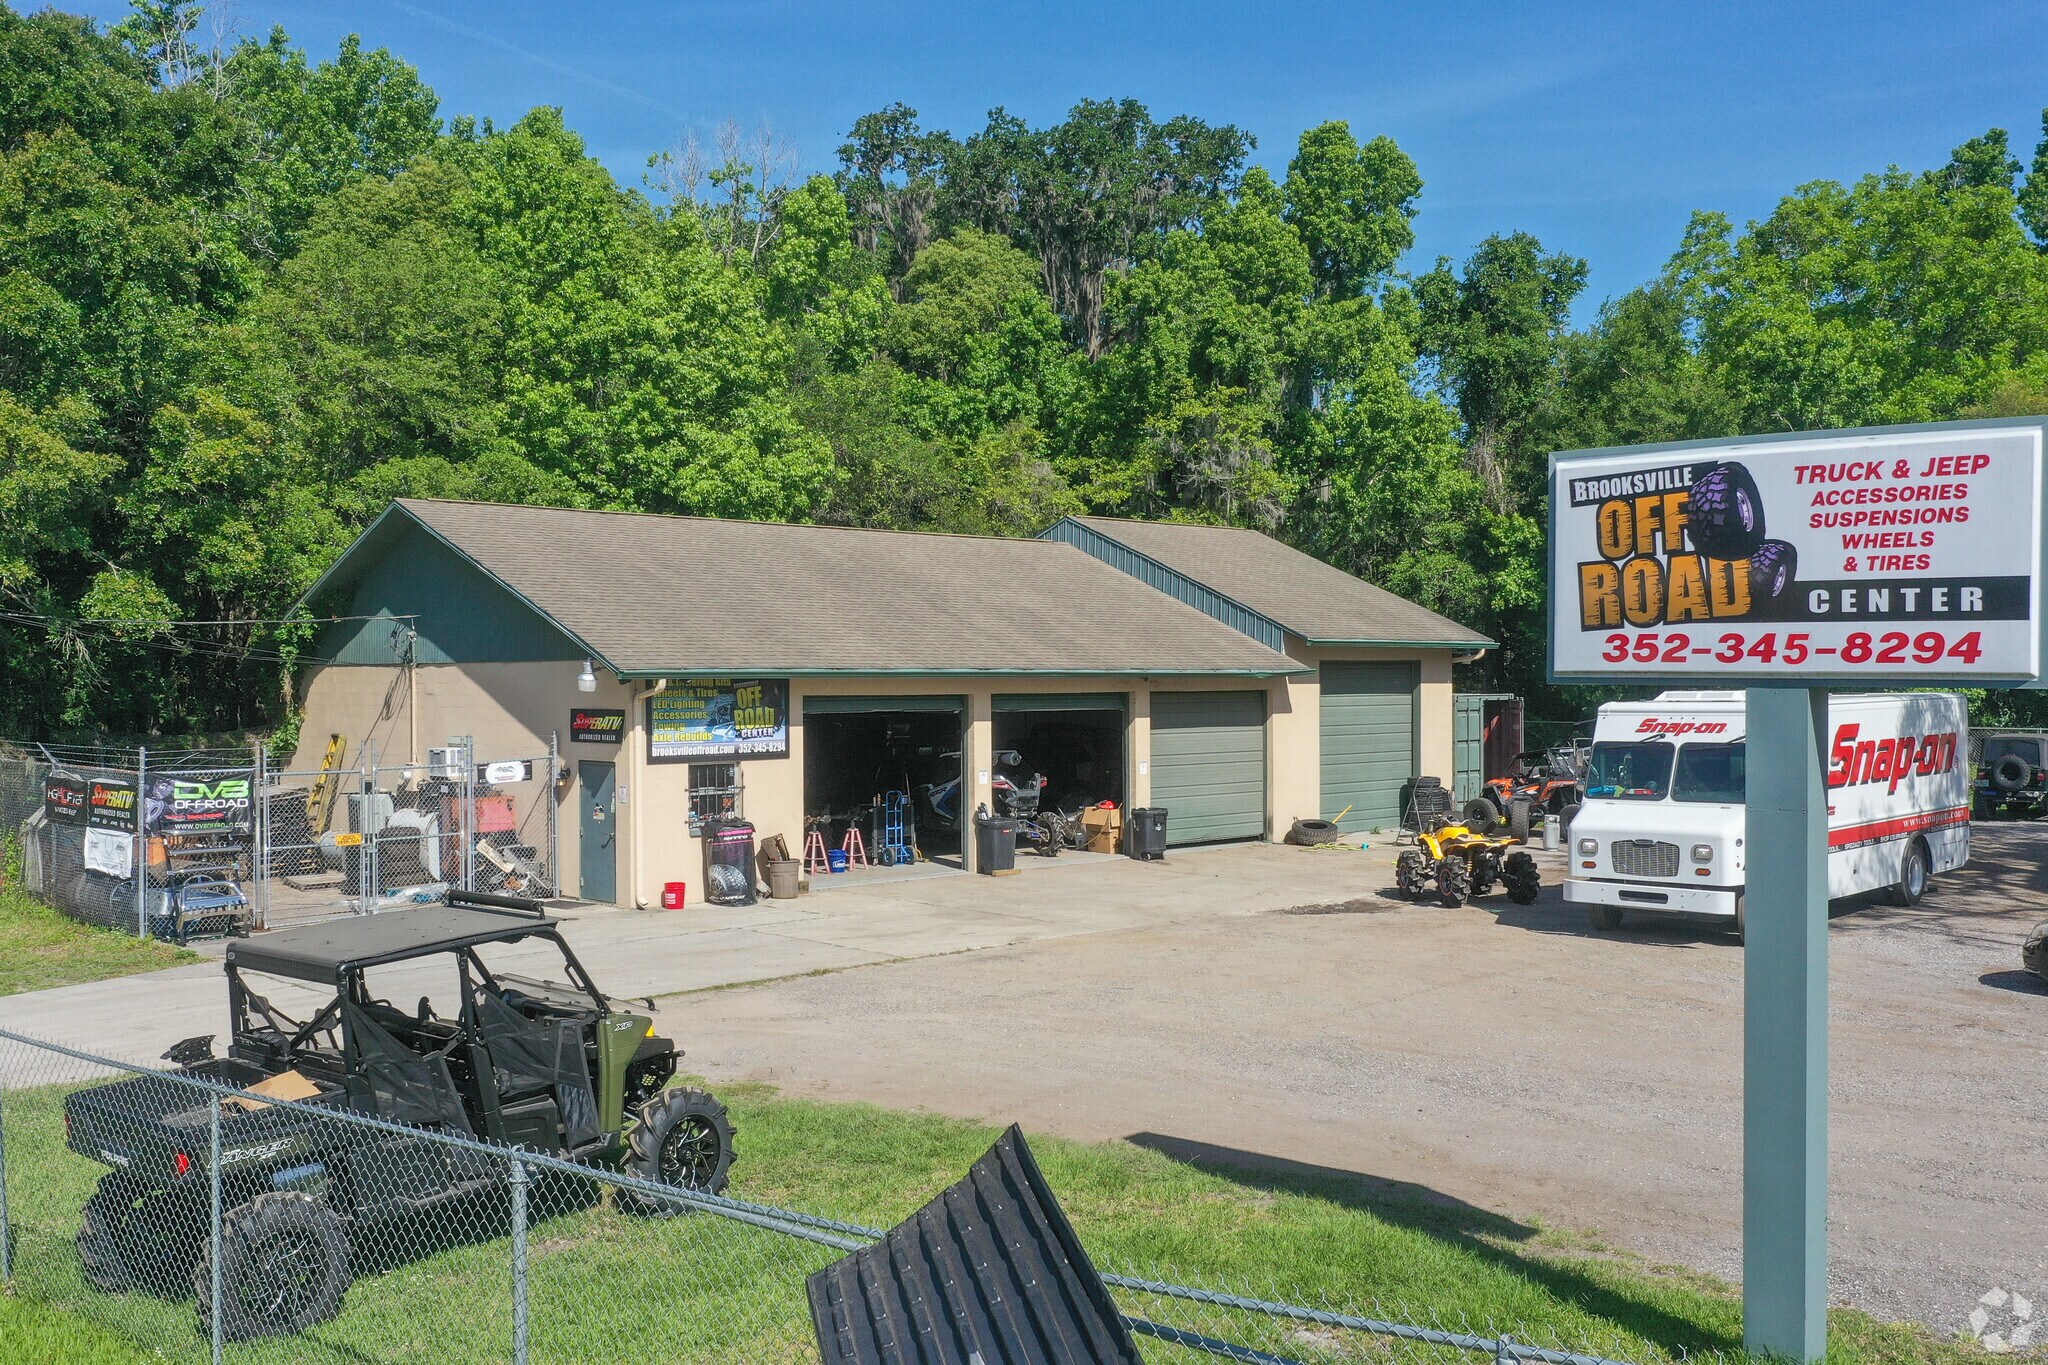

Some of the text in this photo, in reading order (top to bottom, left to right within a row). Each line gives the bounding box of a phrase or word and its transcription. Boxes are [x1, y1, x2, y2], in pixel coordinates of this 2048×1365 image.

[1794, 454, 1990, 485] TRUCK & JEEP
[1574, 467, 1693, 502] BROOKSVILLE
[1810, 484, 1968, 507] ACCESSORIES
[1597, 490, 1690, 560] OFF
[1809, 507, 1969, 529] SUSPENSIONS
[1841, 531, 1934, 550] WHEELS
[1843, 554, 1931, 572] & TIRES
[1582, 555, 1751, 630] ROAD
[1808, 587, 1984, 615] CENTER
[1602, 631, 1982, 665] 352-345-8294
[669, 699, 706, 710] Lighting
[736, 686, 763, 709] OFF
[652, 710, 709, 720] Accessories
[734, 706, 776, 731] ROAD
[652, 731, 714, 742] Axle Rebuilds
[740, 727, 775, 738] CENTER
[1635, 717, 1728, 737] Snap-on
[651, 742, 786, 758] brooksvilleoffroad.com 352-345-8294
[1827, 722, 1957, 797] Snap-on
[173, 779, 249, 801] DV8
[174, 798, 249, 810] OFFROAD
